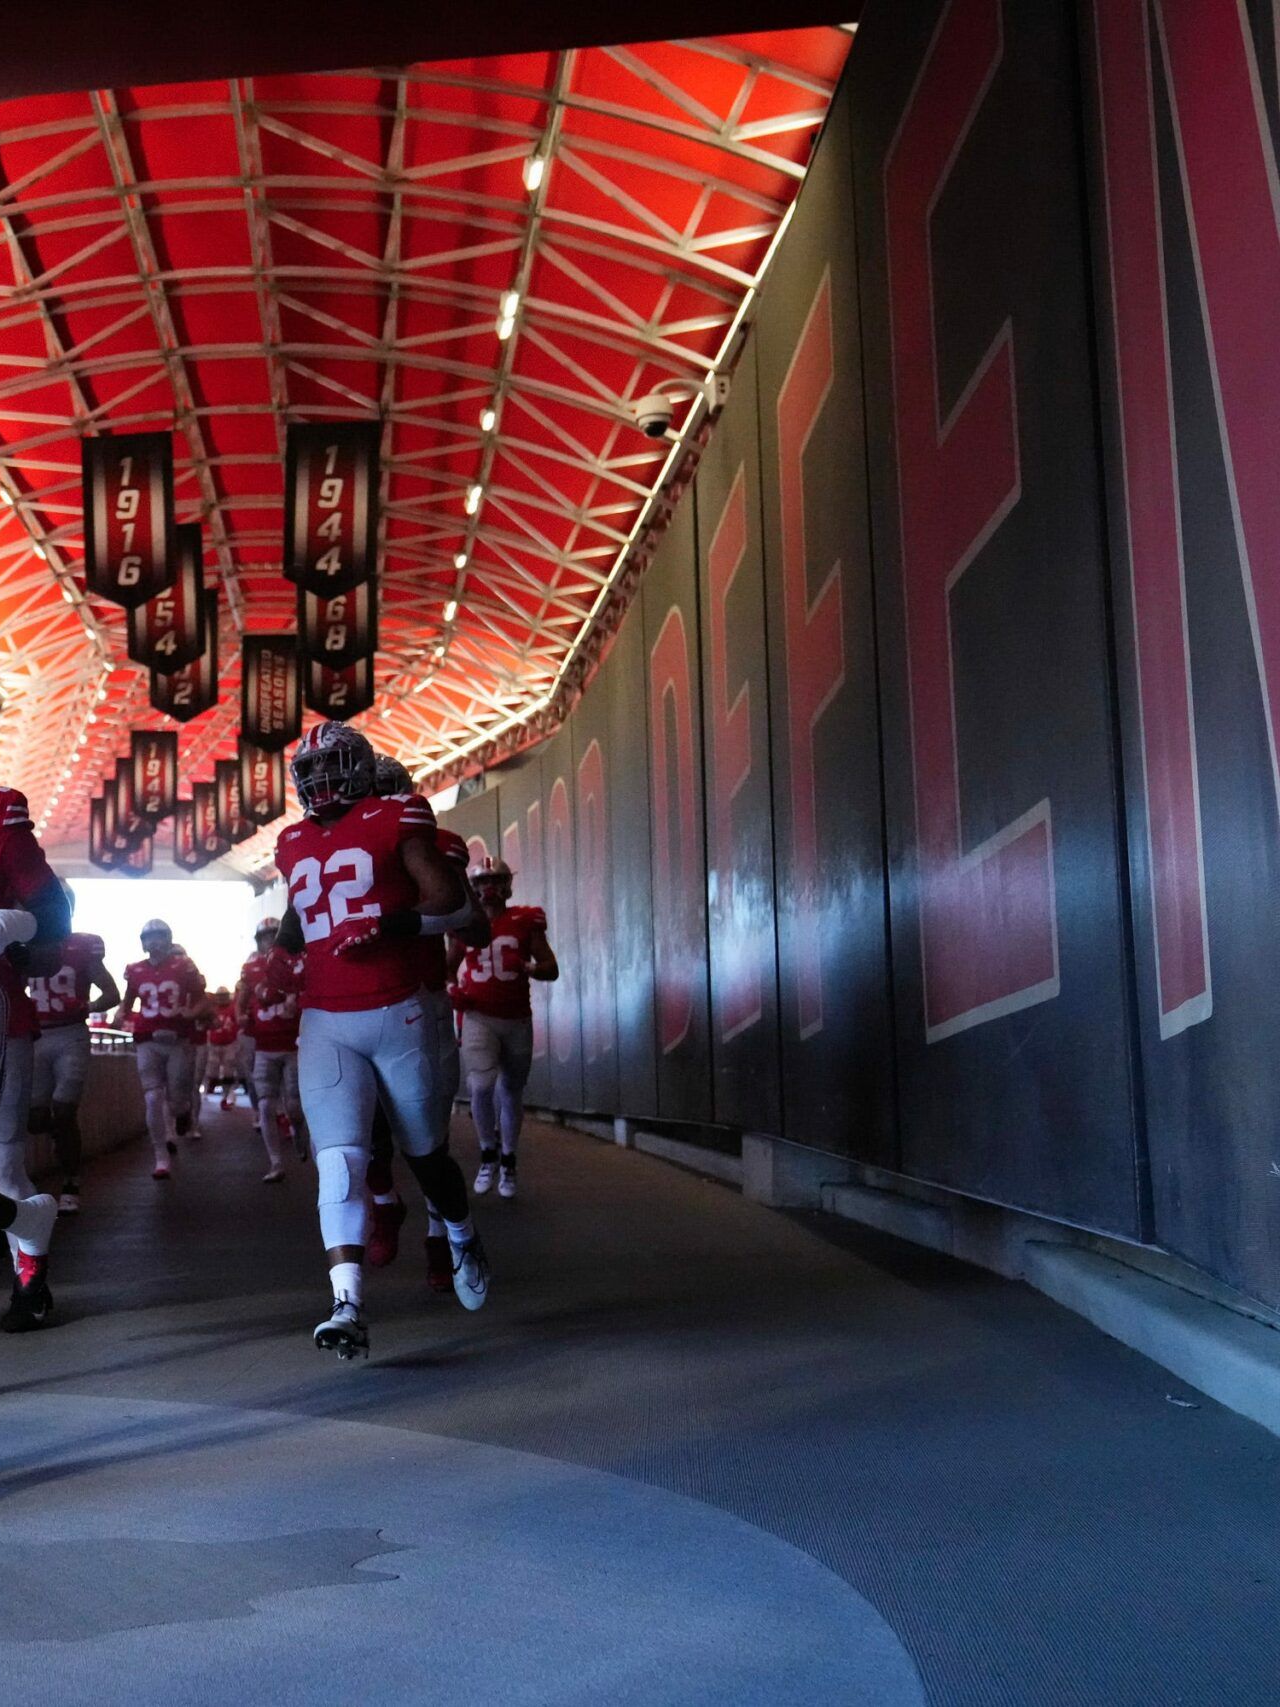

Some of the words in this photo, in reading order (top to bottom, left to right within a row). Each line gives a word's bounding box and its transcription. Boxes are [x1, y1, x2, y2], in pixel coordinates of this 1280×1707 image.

[115, 456, 142, 587] 1916
[315, 444, 344, 576] 1944
[154, 589, 177, 656] 54
[325, 594, 348, 651] 68
[272, 654, 286, 729] SEASONS
[145, 742, 161, 812] 1942
[253, 747, 269, 815] 1954
[289, 847, 382, 943] 22
[27, 965, 77, 1012] 49
[138, 980, 179, 1018] 33
